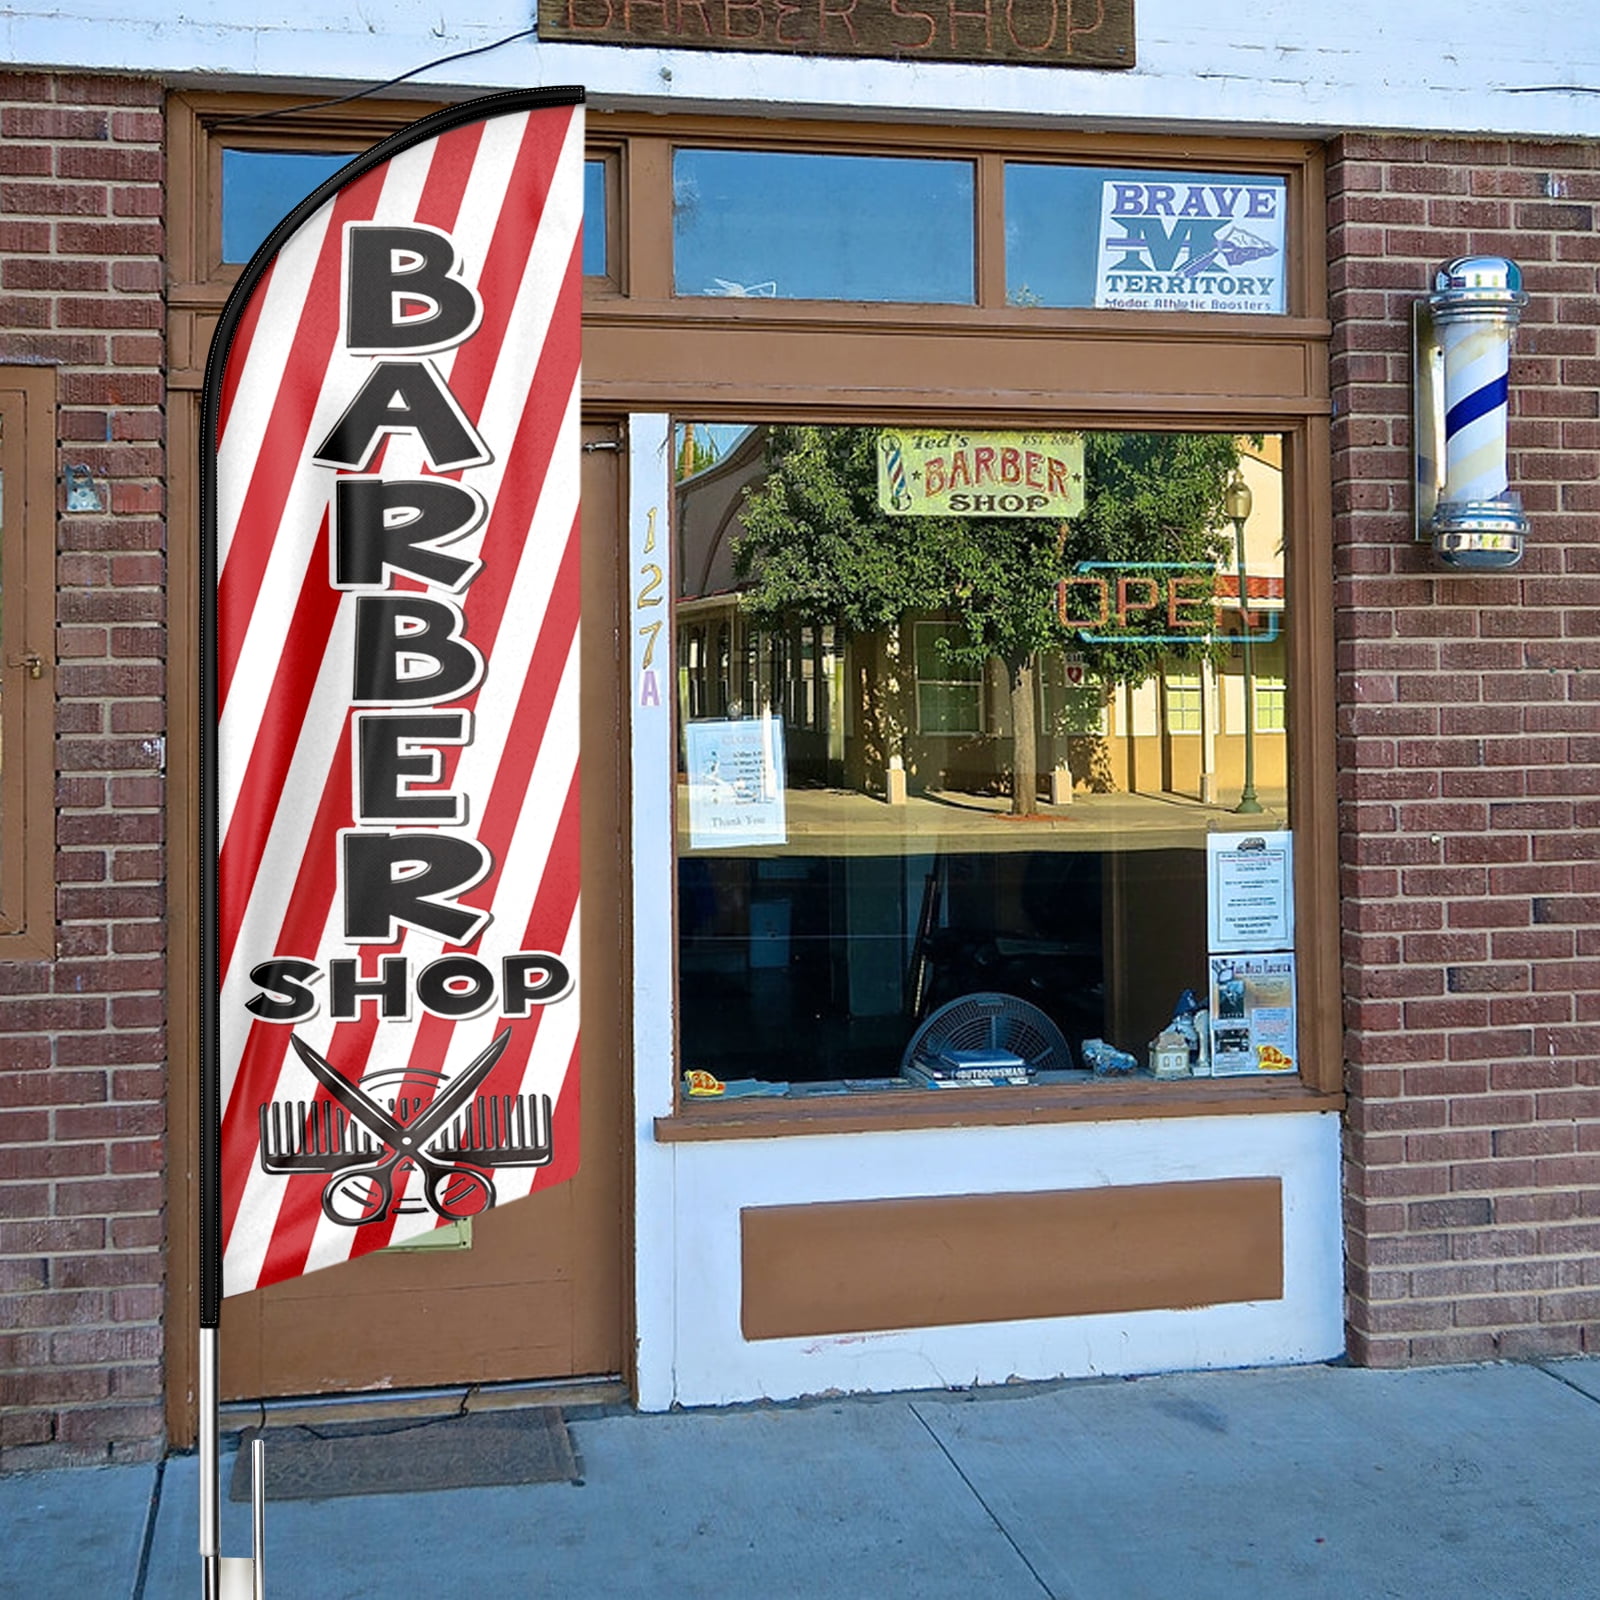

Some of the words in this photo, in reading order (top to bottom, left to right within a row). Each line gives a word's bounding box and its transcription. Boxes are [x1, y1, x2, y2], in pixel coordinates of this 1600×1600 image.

[890, 0, 1104, 55] SHOP
[1110, 184, 1277, 219] BRAVE
[1105, 274, 1275, 296] TERRITORY
[1211, 299, 1272, 311] Boosters
[912, 433, 970, 450] Ted's
[924, 446, 1069, 498] BARBER
[948, 494, 1050, 512] SHOP
[312, 223, 494, 946] BARBER
[244, 953, 576, 1024] SHOP
